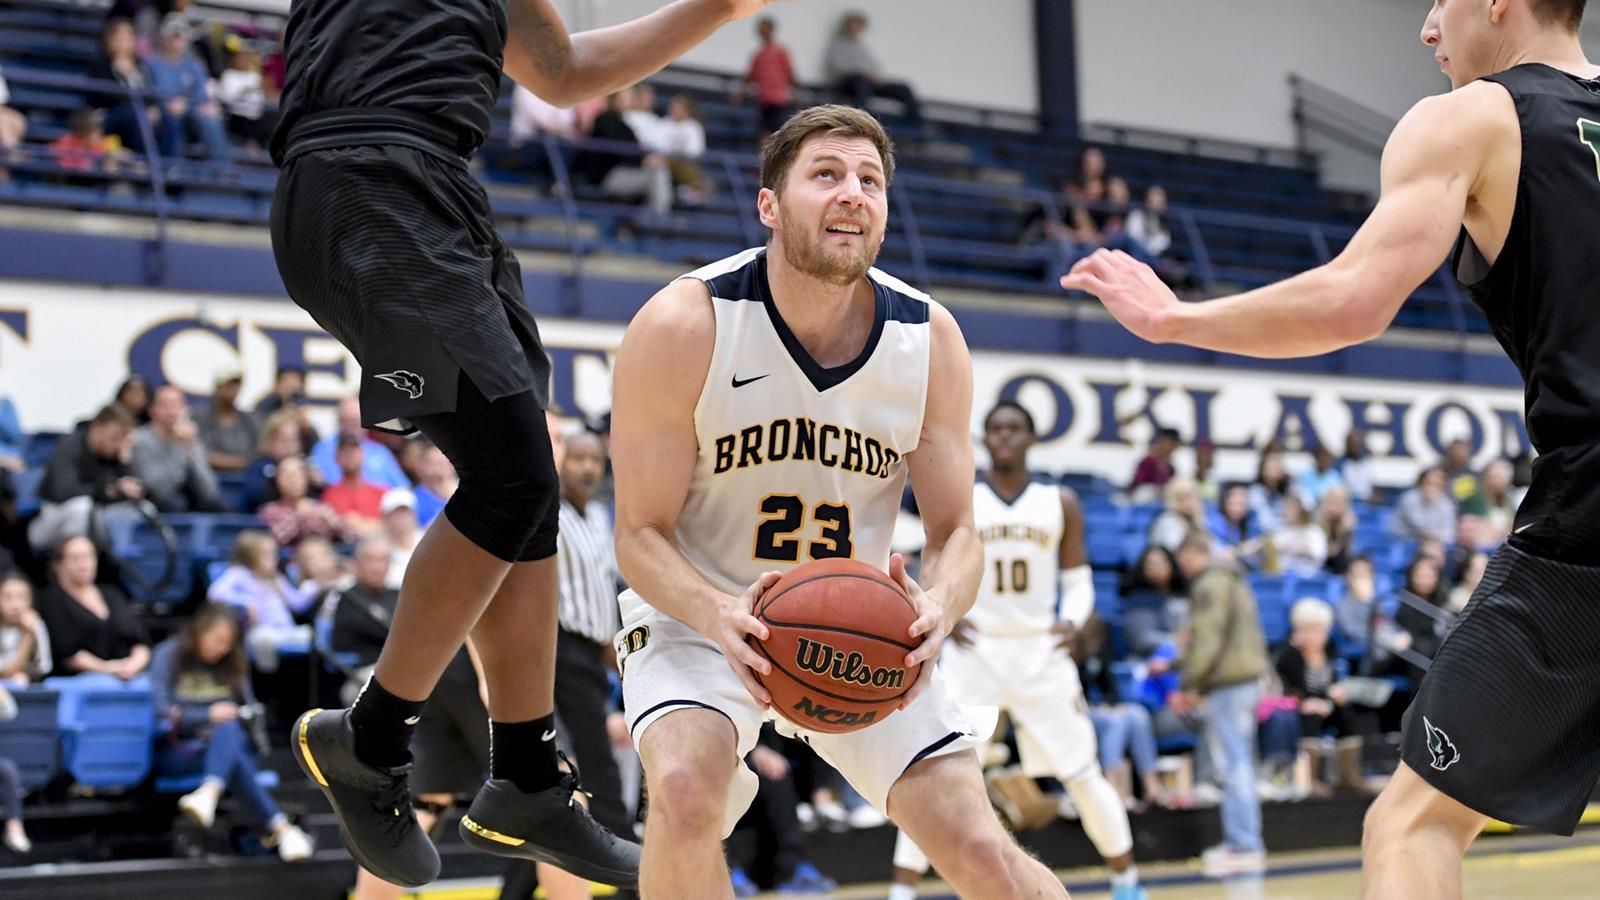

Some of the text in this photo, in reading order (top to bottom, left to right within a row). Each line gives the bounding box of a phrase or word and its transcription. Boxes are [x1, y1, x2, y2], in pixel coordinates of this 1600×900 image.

[713, 417, 902, 479] BRONCHOS
[752, 492, 855, 563] 23
[994, 557, 1028, 596] 10
[796, 636, 905, 690] Wilson
[793, 696, 878, 726] NCAA
